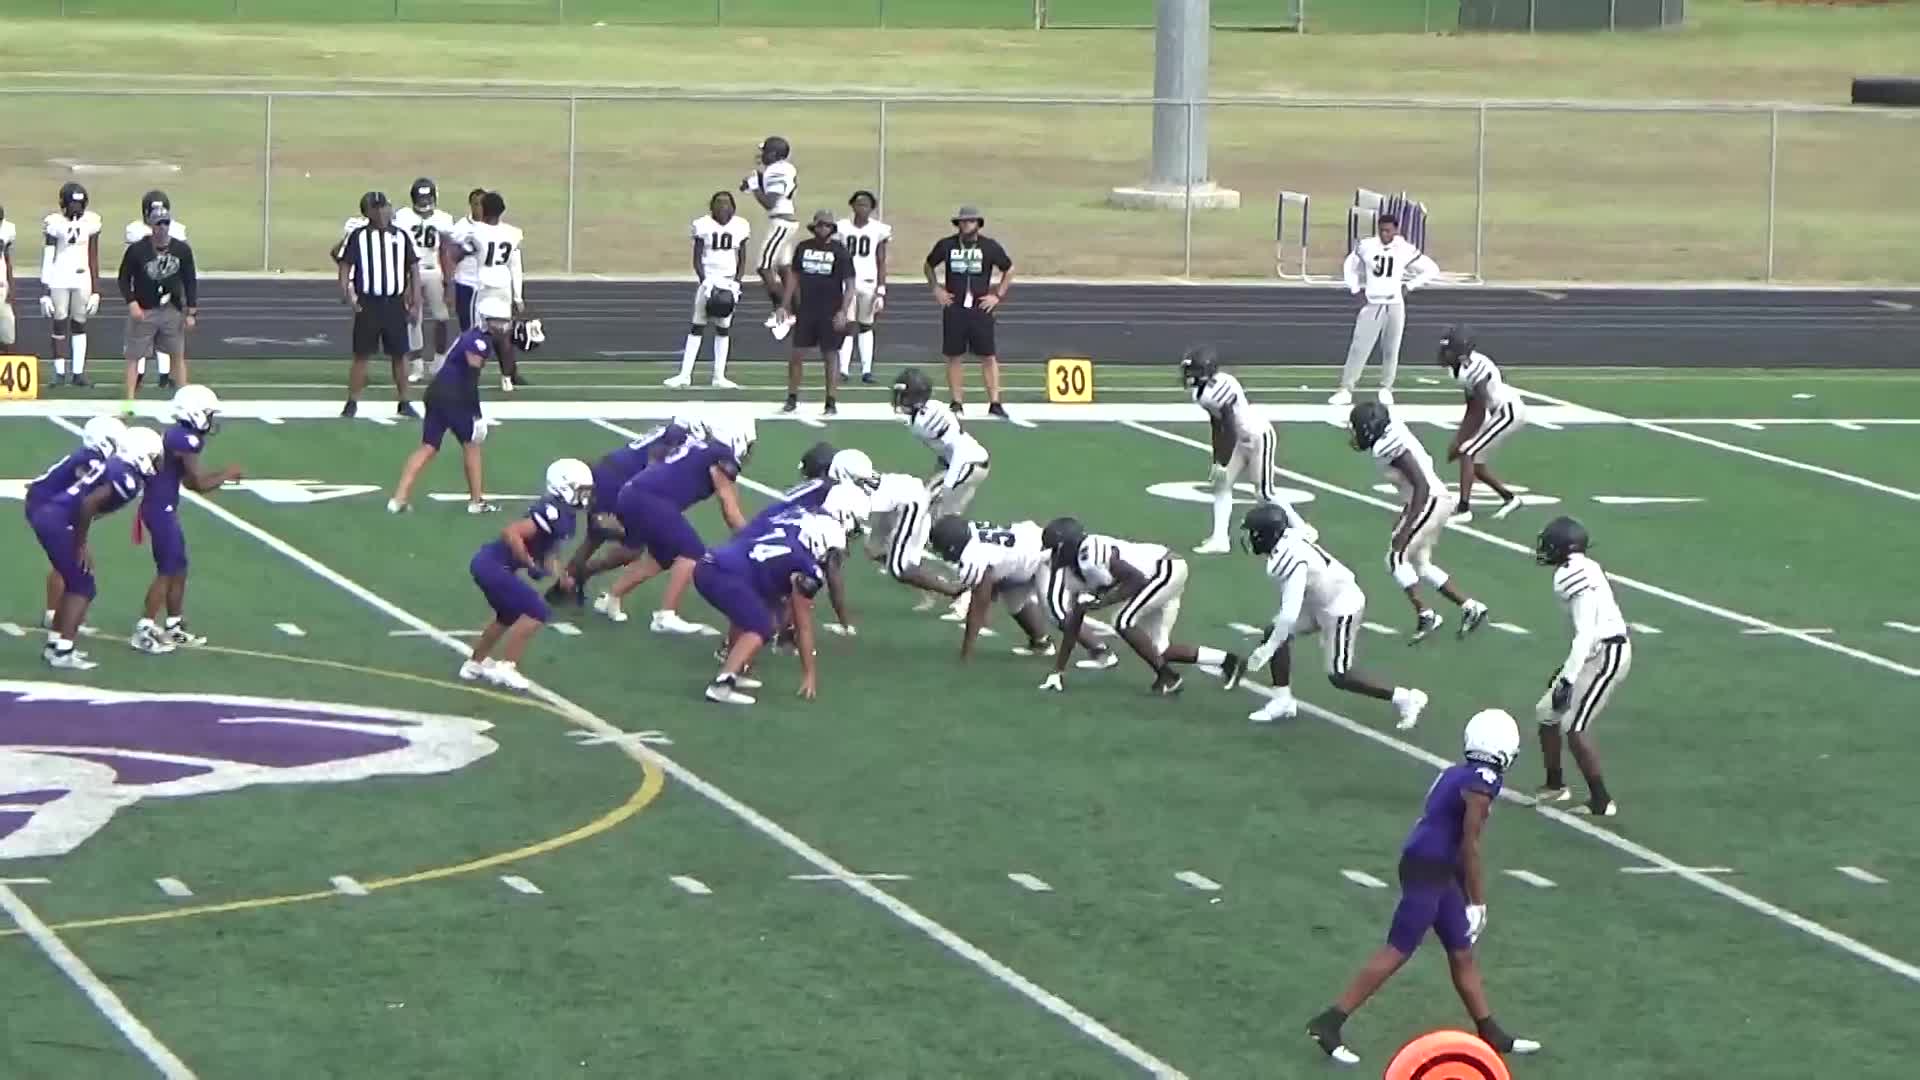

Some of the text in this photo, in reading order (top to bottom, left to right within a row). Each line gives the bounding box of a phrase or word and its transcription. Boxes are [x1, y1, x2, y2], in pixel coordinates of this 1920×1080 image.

[410, 224, 437, 248] 26
[711, 231, 733, 251] 10
[484, 241, 512, 267] 13
[1373, 255, 1394, 278] 31
[0, 361, 31, 392] 40
[1055, 364, 1086, 396] 30
